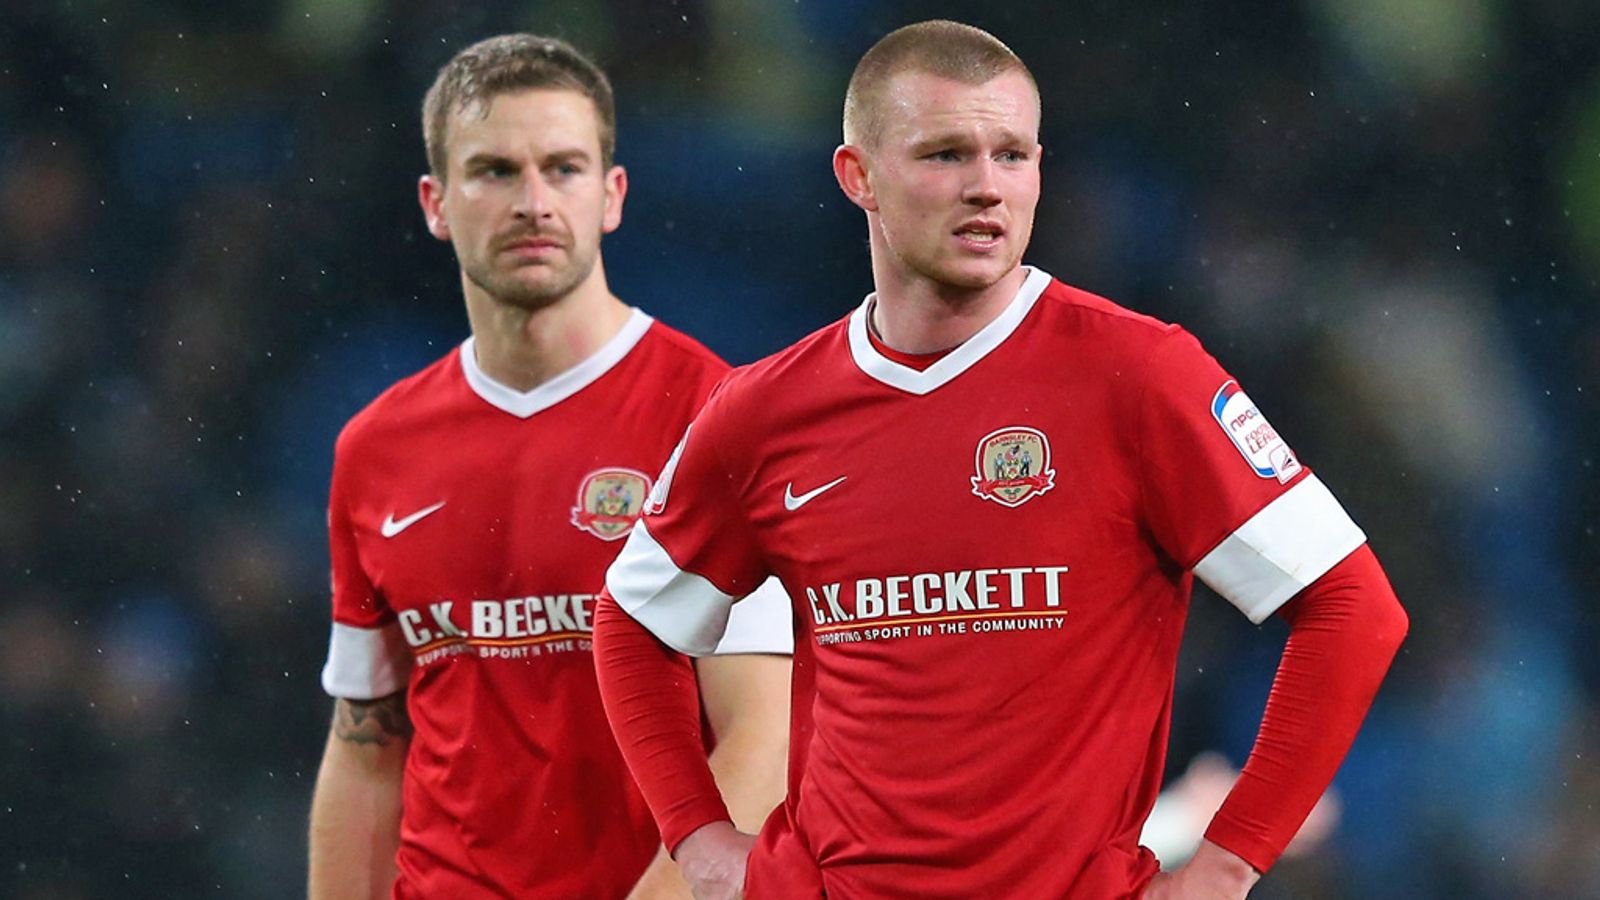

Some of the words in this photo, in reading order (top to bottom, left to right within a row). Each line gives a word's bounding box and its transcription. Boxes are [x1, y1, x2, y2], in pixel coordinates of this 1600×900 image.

[471, 593, 600, 638] BECKE
[864, 627, 911, 641] SPORT
[917, 626, 932, 636] IN
[938, 622, 966, 635] THE
[972, 618, 1064, 633] COMMUNITY
[479, 646, 528, 659] SPORT
[546, 640, 574, 654] THE
